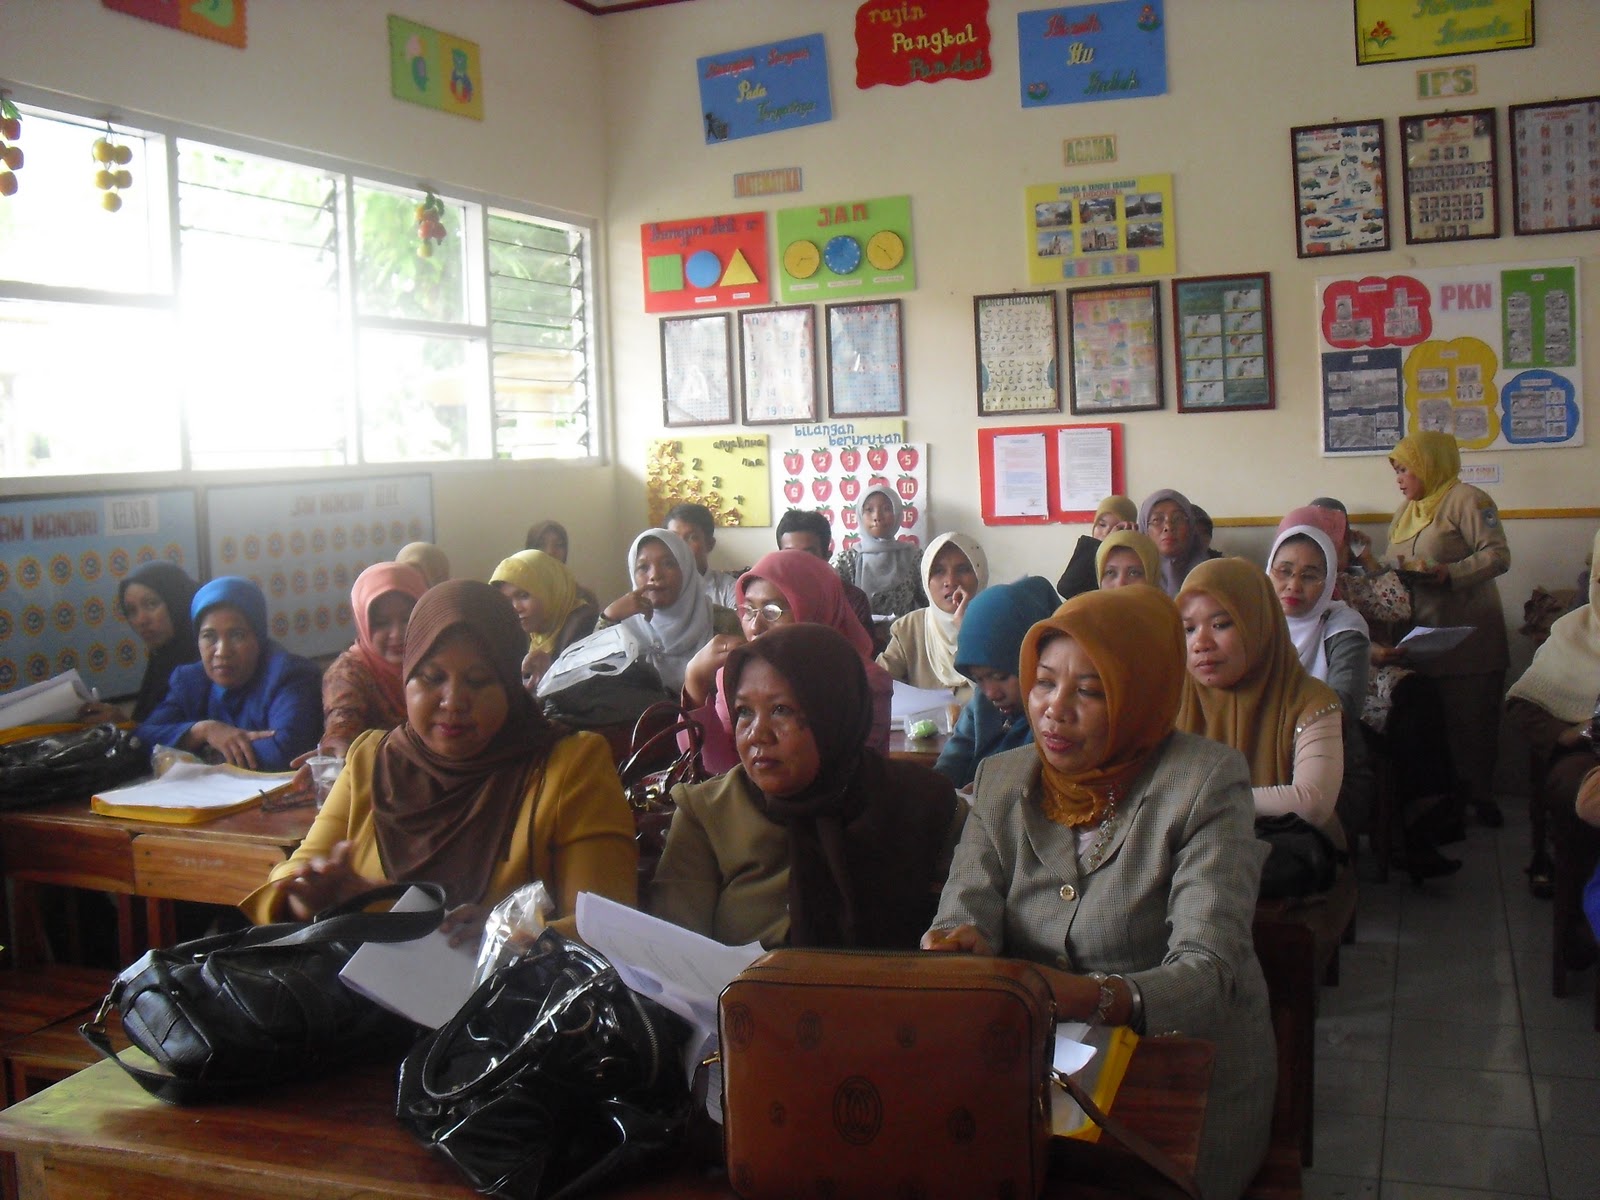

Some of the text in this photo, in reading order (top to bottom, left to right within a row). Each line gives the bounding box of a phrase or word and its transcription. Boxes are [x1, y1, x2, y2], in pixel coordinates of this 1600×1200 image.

[869, 1, 926, 28] rajin
[892, 23, 978, 54] Pangkal
[910, 48, 985, 79] Pandai
[736, 80, 767, 103] Pada
[1418, 69, 1474, 97] IPS
[1067, 138, 1115, 163] AGAMA
[1441, 283, 1492, 311] PKN
[795, 424, 855, 437] bilangan
[829, 433, 902, 446] berurutan
[692, 458, 702, 471] 2
[791, 454, 912, 469] 1 2 3 4 5
[712, 476, 721, 489] 3
[791, 482, 915, 498] 6 7 8 10
[903, 511, 913, 522] 15
